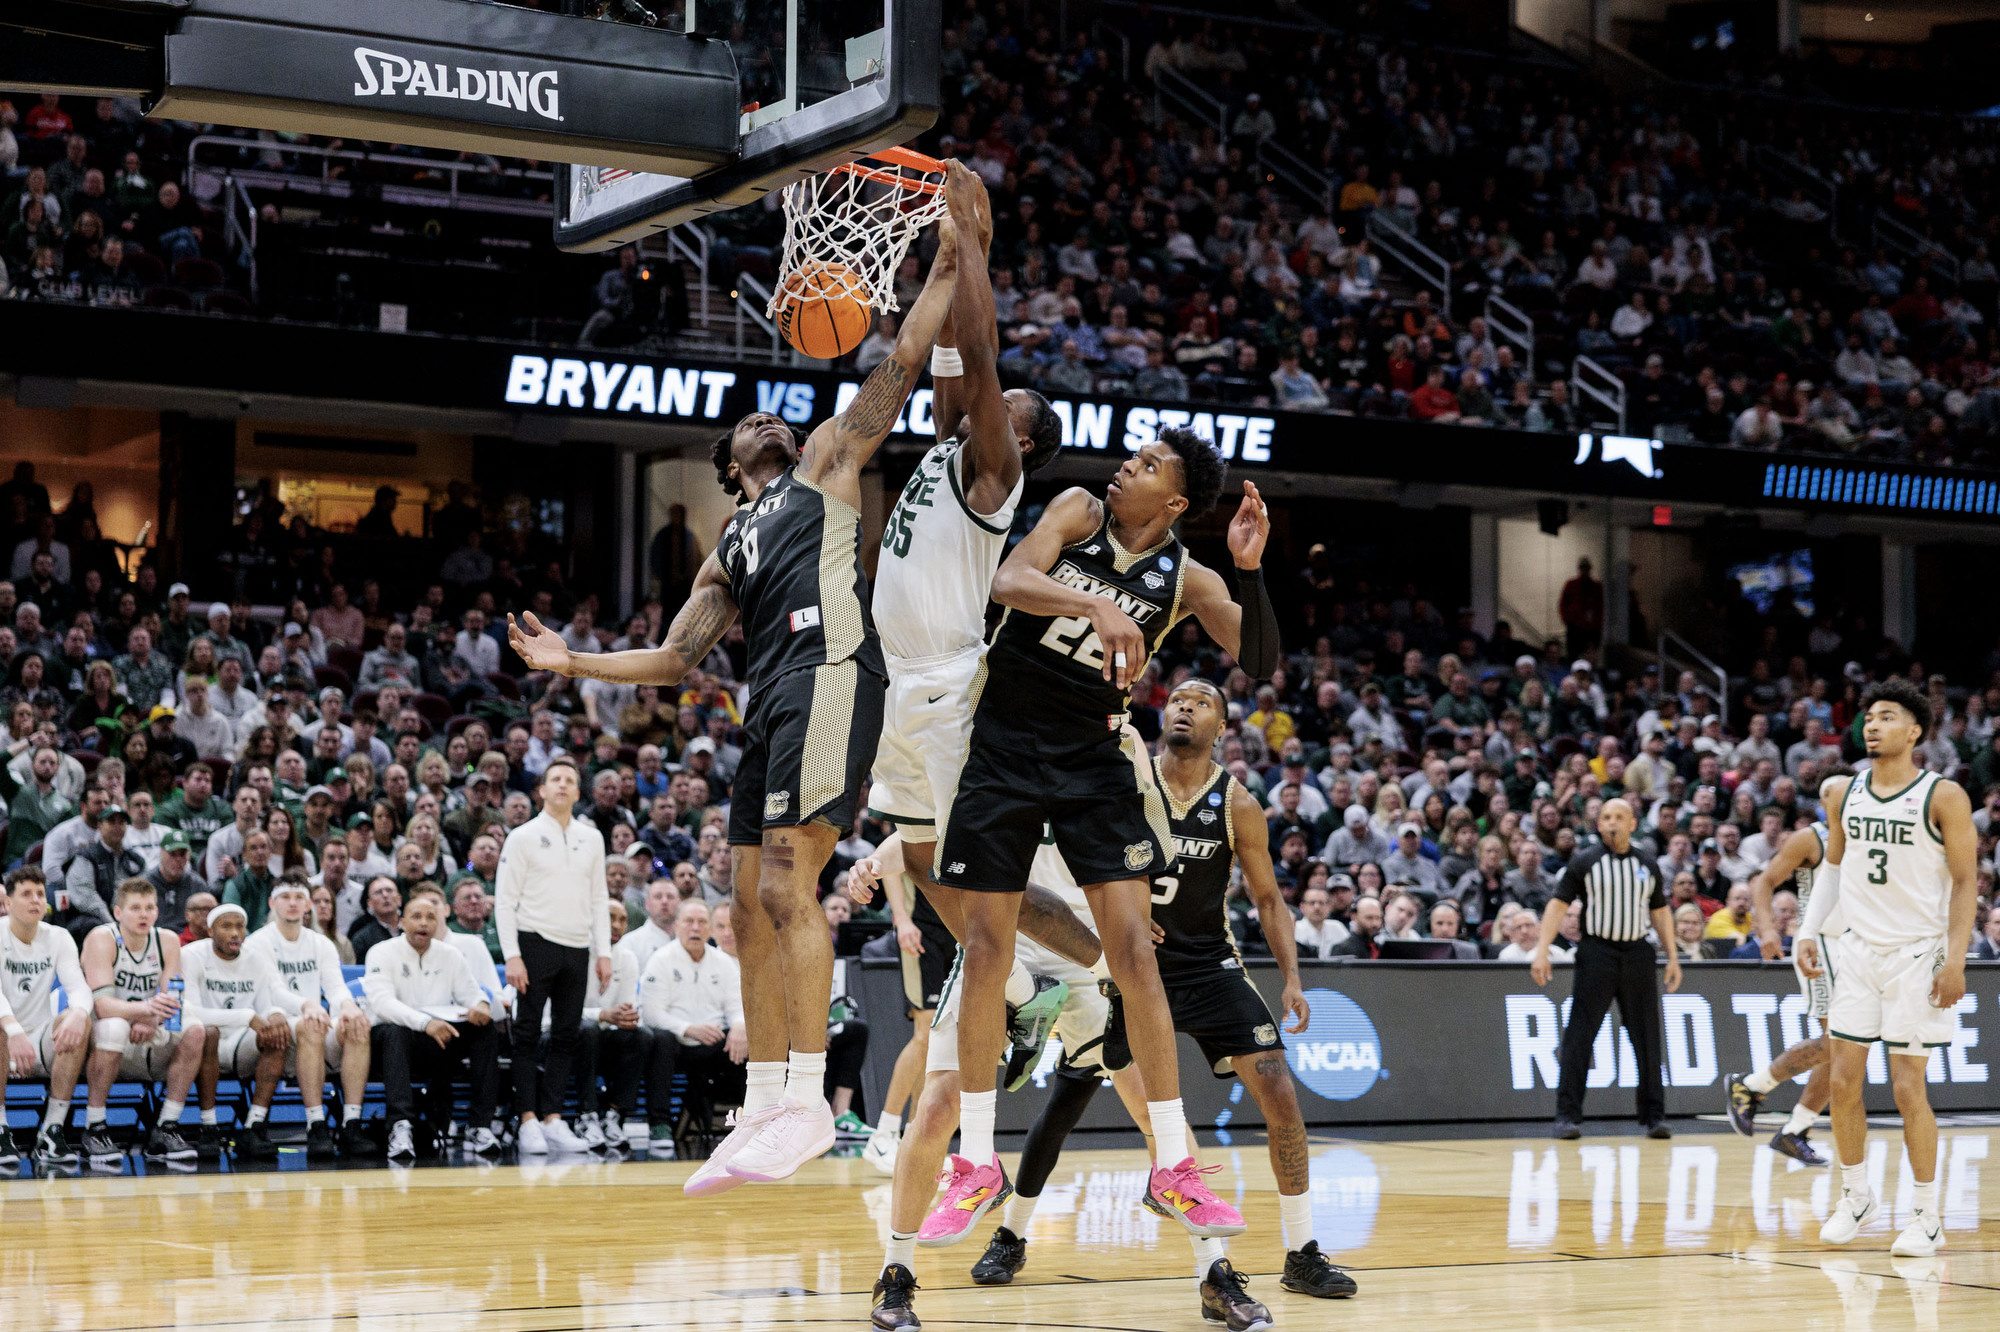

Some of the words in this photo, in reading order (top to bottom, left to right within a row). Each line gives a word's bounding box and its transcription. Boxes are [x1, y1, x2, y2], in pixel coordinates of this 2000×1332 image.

[354, 47, 560, 121] SPALDING
[37, 278, 84, 299] CLUB
[505, 354, 737, 419] BRYANT
[756, 379, 816, 424] VS
[1050, 562, 1155, 620] BRYANT
[802, 611, 809, 623] L
[1847, 816, 1917, 846] STATE
[1867, 848, 1888, 885] 3
[114, 970, 159, 992] STATE
[1296, 1042, 1380, 1071] NCAA
